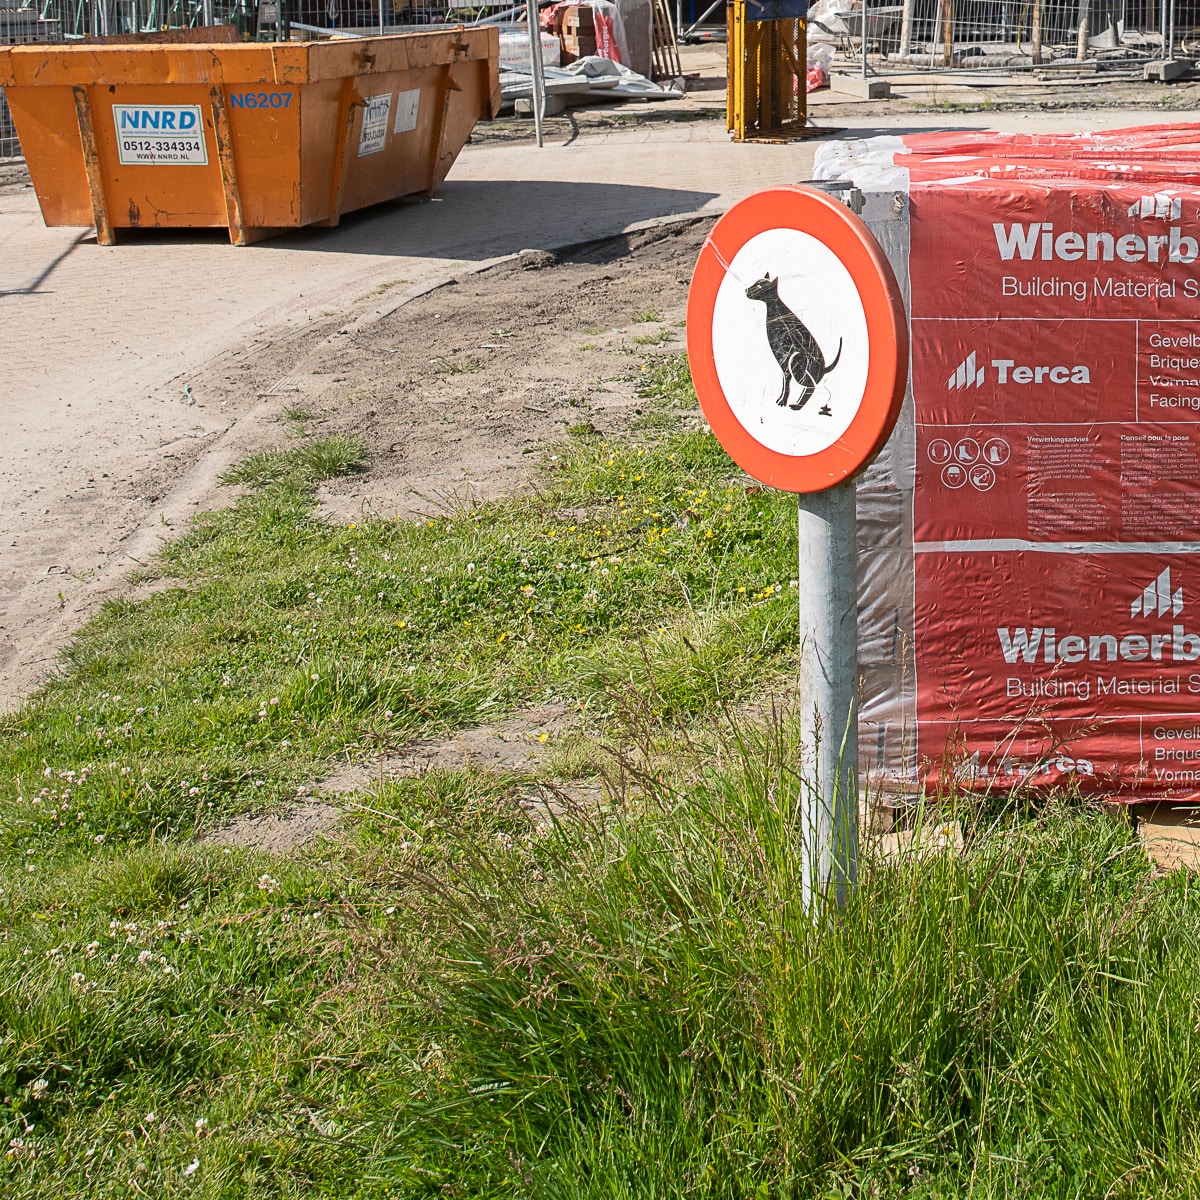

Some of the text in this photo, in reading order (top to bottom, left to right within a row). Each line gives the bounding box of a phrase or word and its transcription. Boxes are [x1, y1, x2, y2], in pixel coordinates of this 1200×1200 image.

[230, 93, 292, 108] N6207
[120, 110, 196, 130] NNRD
[124, 142, 200, 151] 0512-334334
[1002, 276, 1088, 302] Building
[1094, 277, 1178, 298] Material
[992, 360, 1091, 386] Terca
[1150, 394, 1200, 412] Facing
[1006, 676, 1091, 700] Building
[1097, 674, 1182, 696] Material
